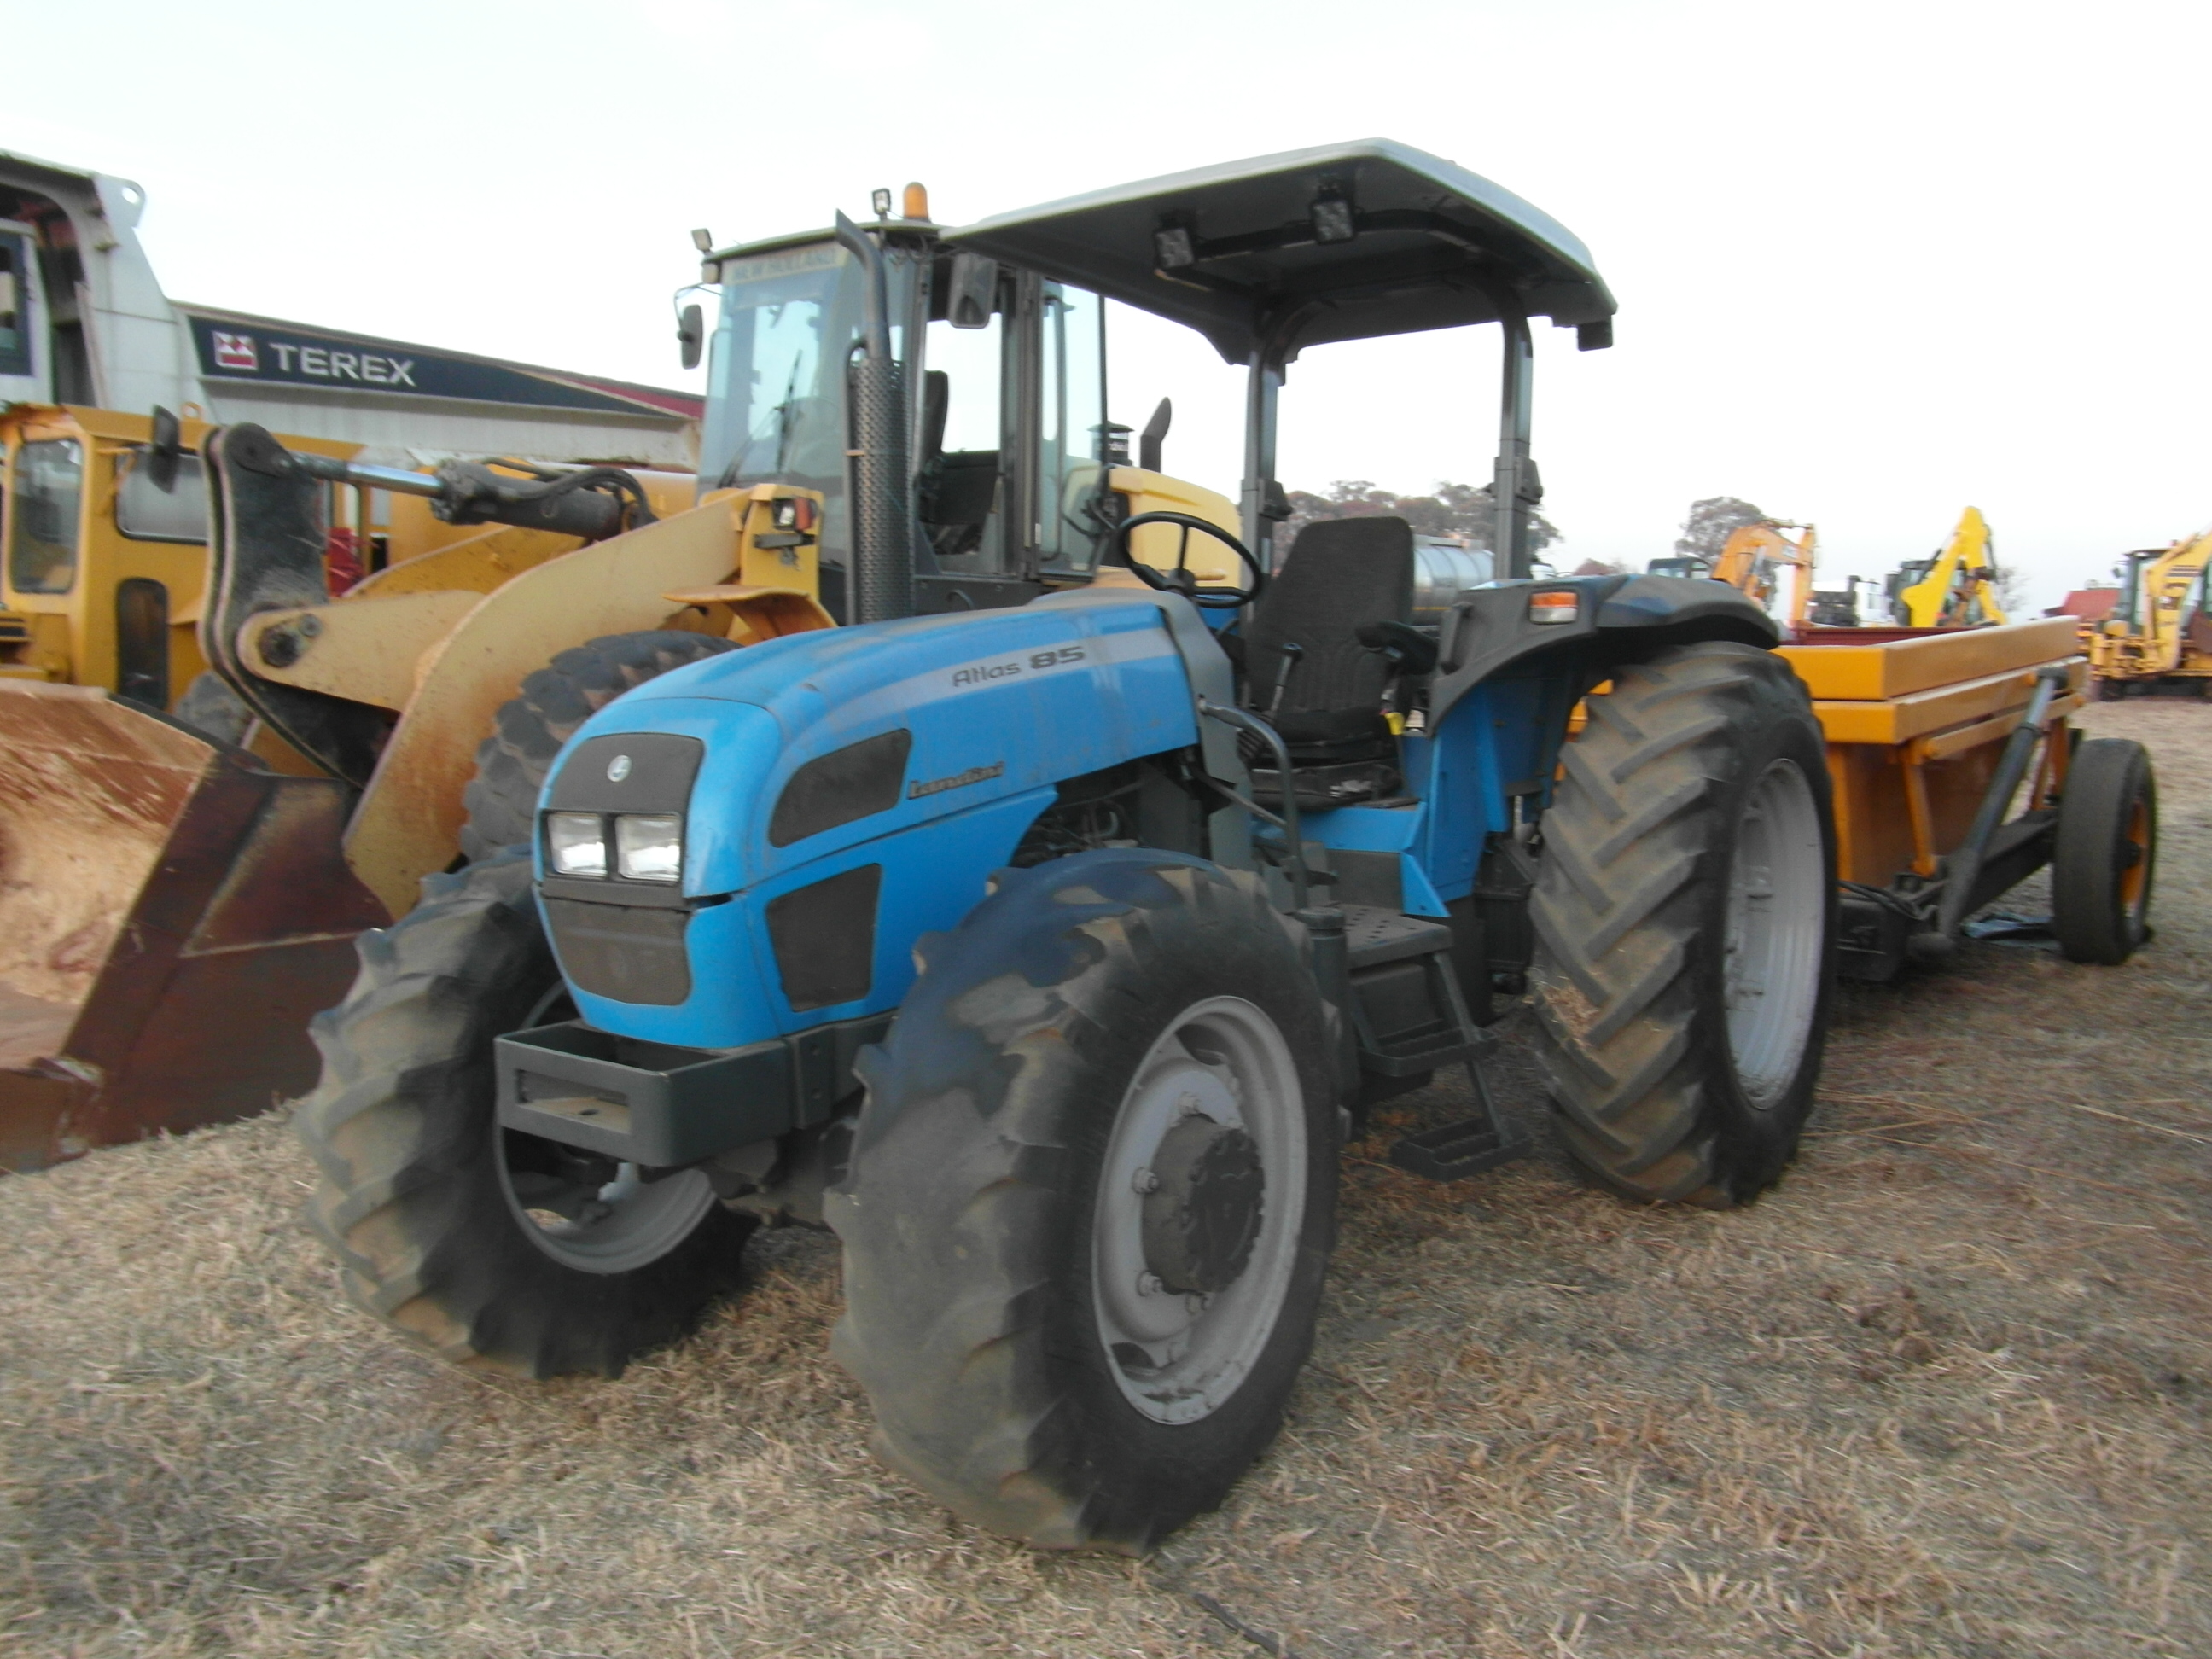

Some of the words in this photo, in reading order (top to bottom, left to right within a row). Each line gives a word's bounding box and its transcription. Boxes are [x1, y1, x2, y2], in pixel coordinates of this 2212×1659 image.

[269, 342, 416, 387] TEREX
[952, 663, 1021, 687] Atlas
[1029, 646, 1085, 669] 85
